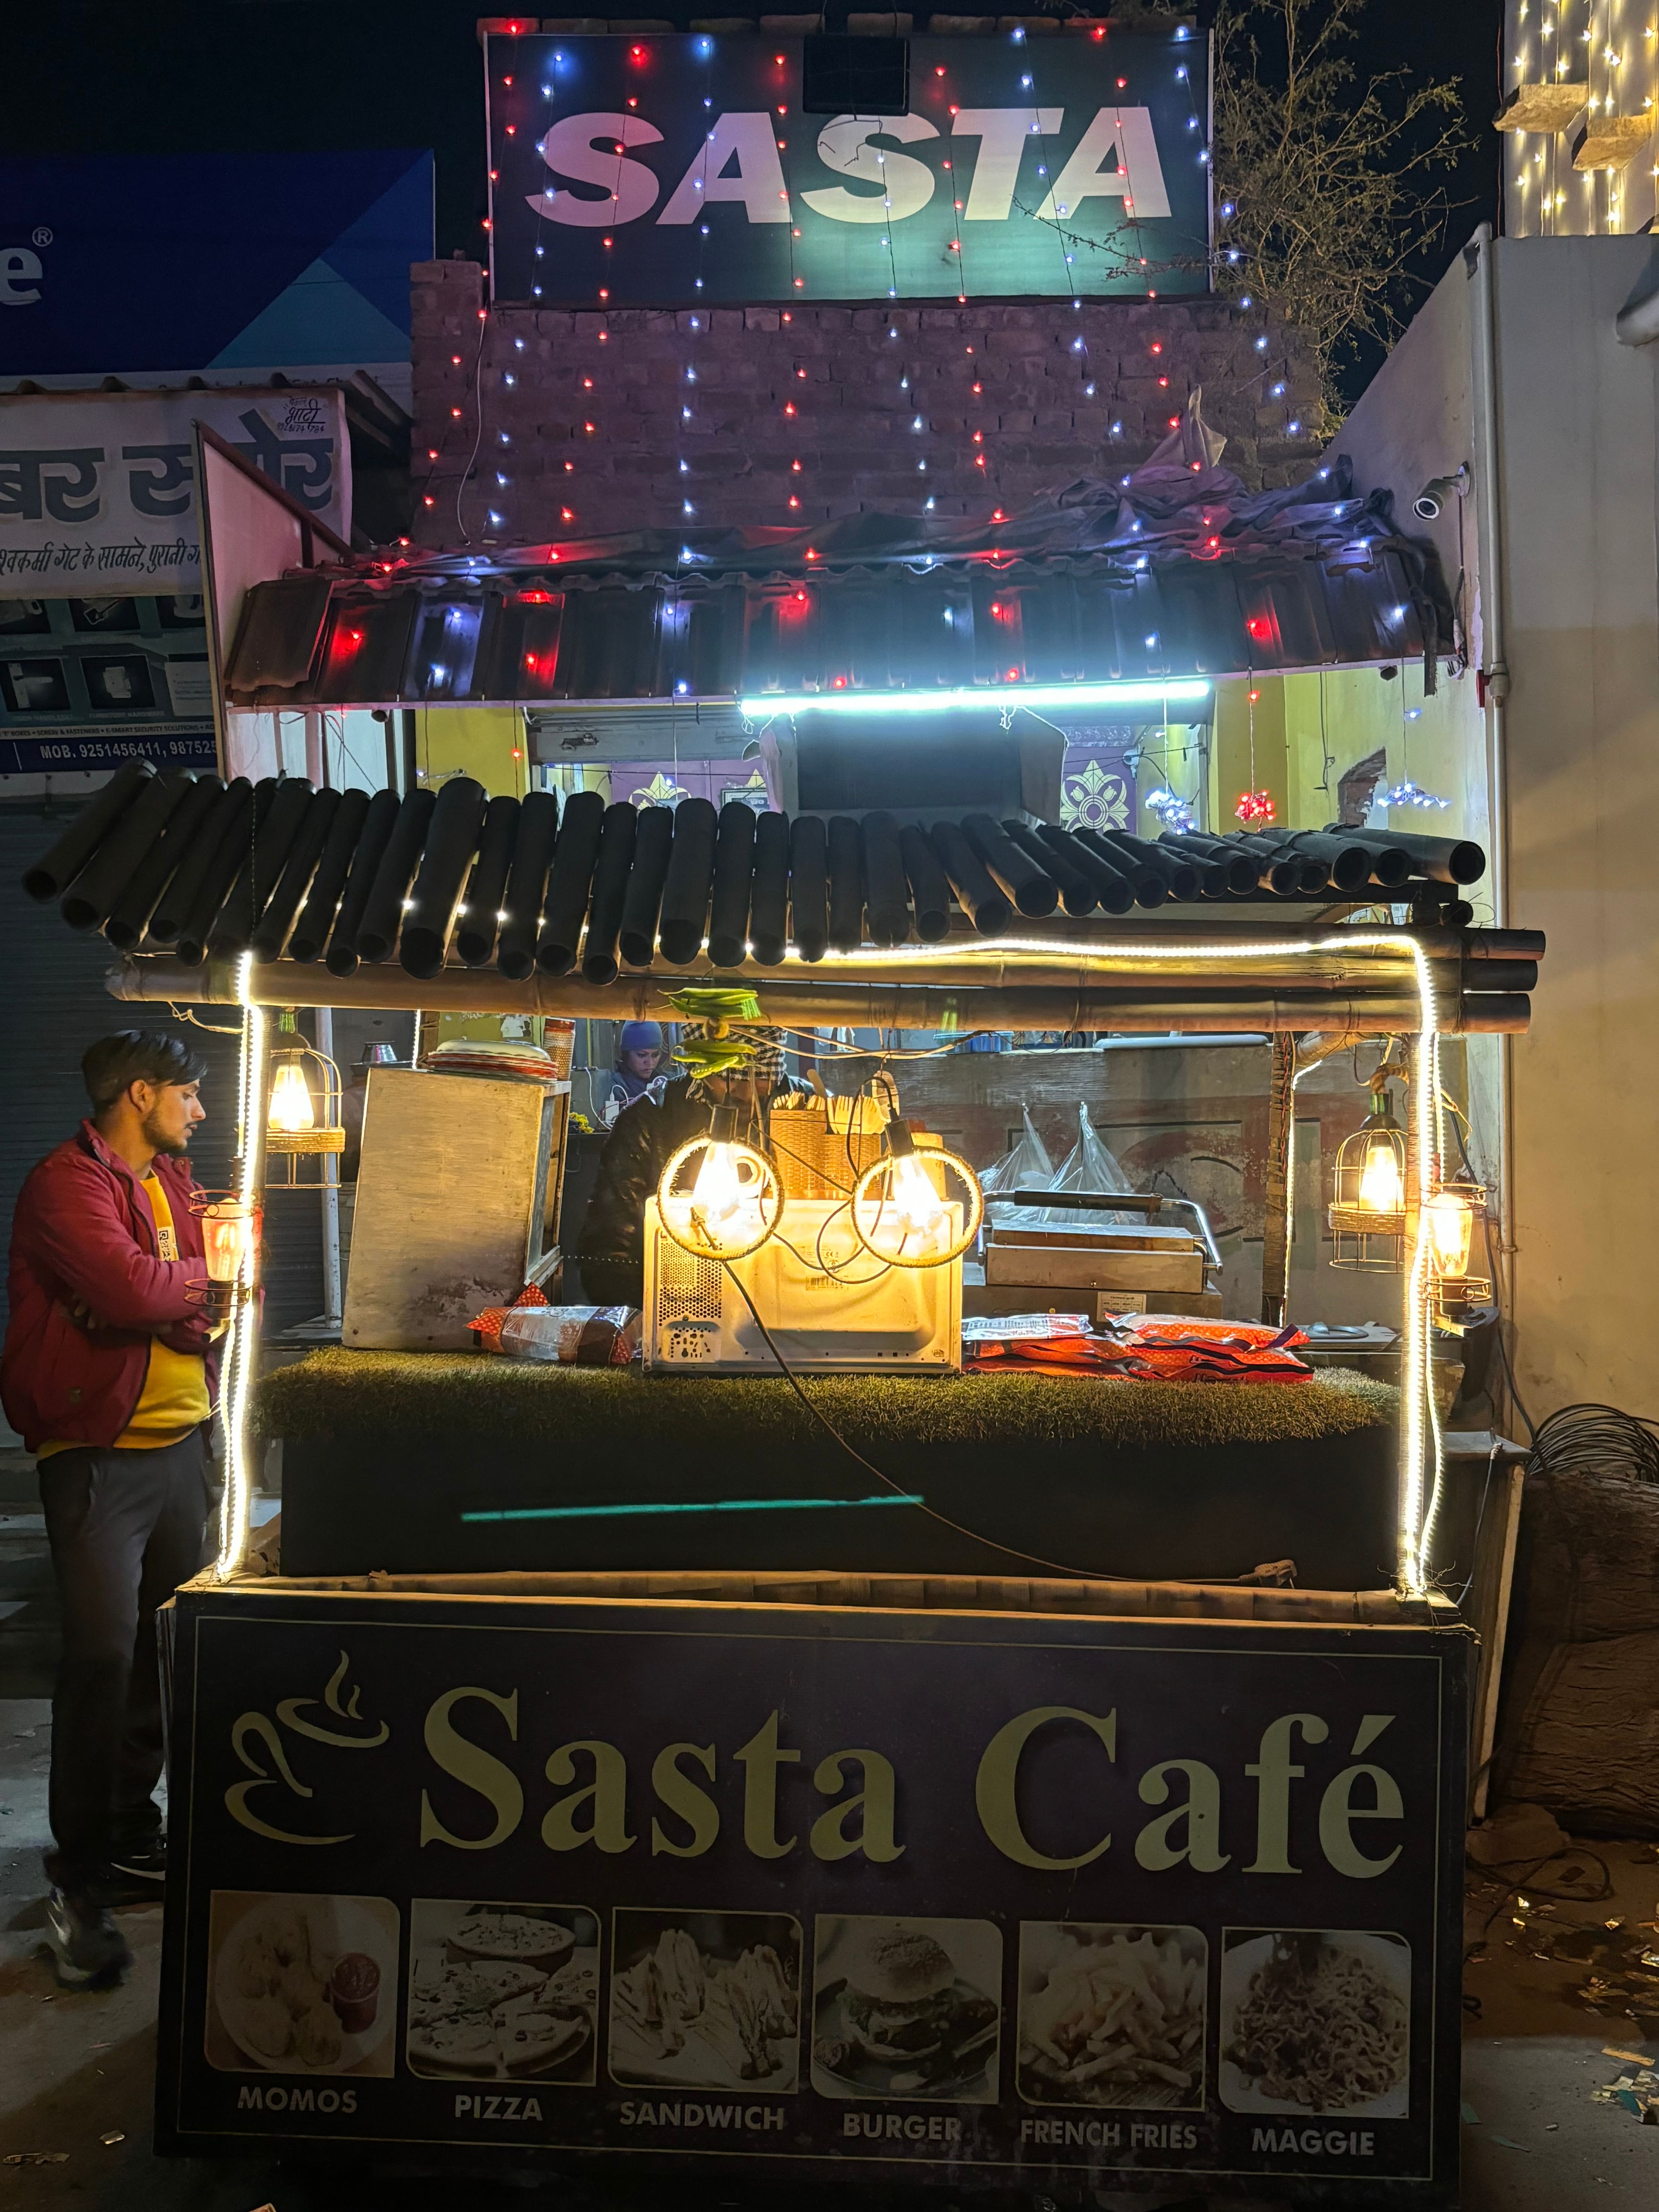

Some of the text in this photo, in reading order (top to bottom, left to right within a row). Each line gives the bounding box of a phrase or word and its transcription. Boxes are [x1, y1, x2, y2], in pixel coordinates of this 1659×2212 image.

[524, 106, 1172, 227] SASTA
[40, 745, 76, 759] MOB.
[79, 742, 167, 758] 9251456411,
[420, 1686, 1405, 1879] Sasta Café
[237, 2086, 358, 2113] MOMOS
[455, 2094, 543, 2121] PIZZA
[620, 2101, 785, 2130] SANDWICH
[843, 2113, 962, 2141] BURGER
[1020, 2119, 1198, 2149] FRENCH FRIES
[1251, 2128, 1375, 2156] MAGGIE
